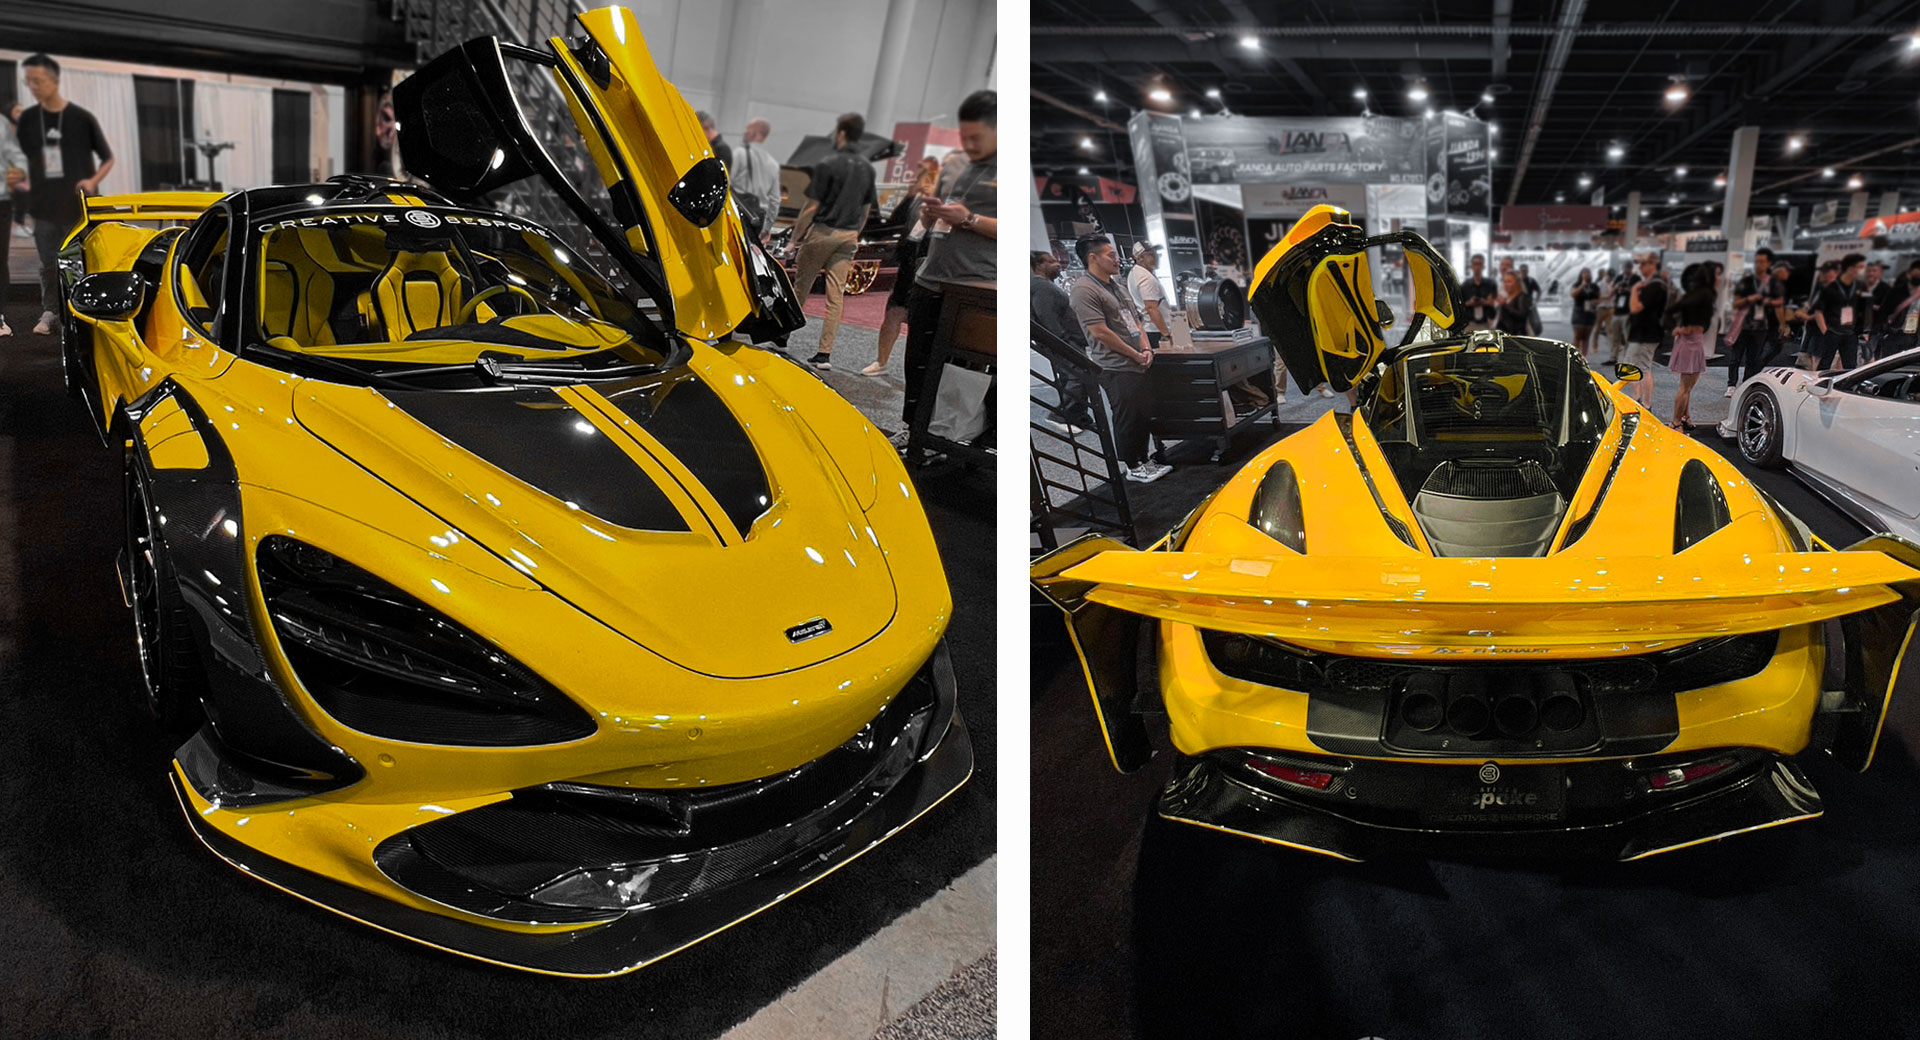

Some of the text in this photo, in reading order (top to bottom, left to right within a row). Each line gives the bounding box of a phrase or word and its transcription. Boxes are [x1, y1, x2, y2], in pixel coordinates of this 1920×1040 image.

[1236, 162, 1384, 173] JIANDA AUTO PARTS FACTORY
[258, 213, 550, 239] CREATIVE BESPOKE
